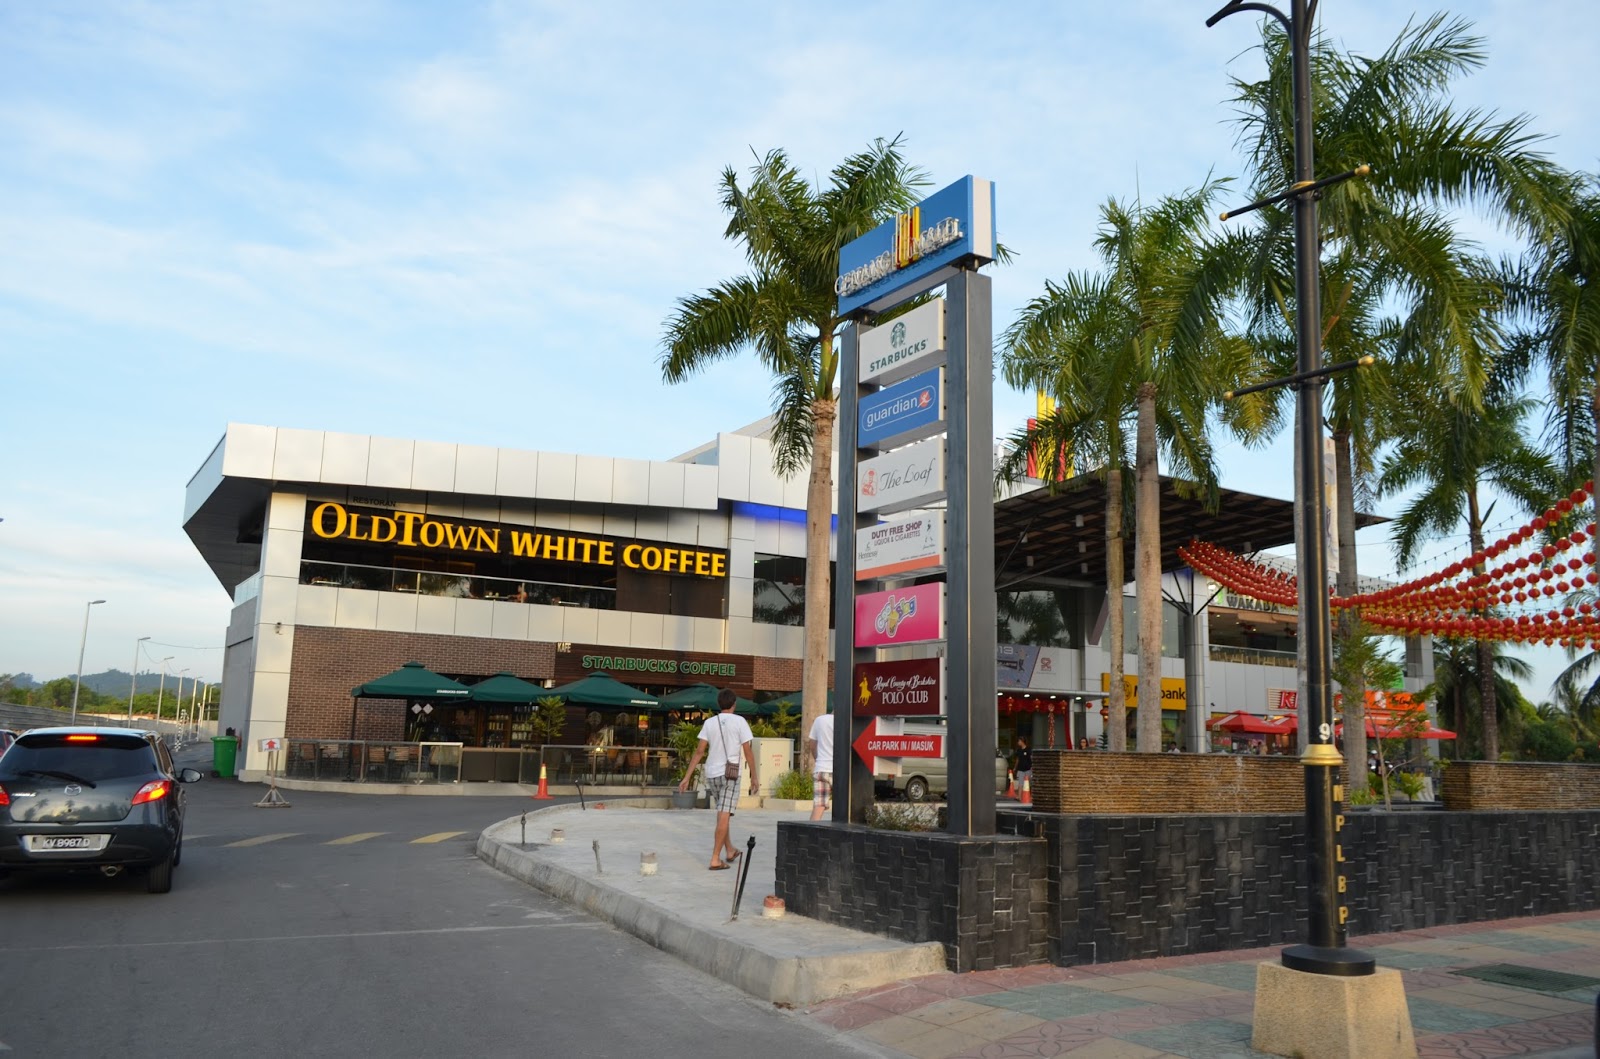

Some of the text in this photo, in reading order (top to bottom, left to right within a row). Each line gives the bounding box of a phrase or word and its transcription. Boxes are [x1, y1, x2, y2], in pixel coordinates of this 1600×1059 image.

[870, 339, 927, 372] STARBUCKS
[866, 395, 918, 427] guardian
[879, 457, 936, 491] The Loaf
[353, 496, 396, 508] RESTORAN
[871, 520, 922, 539] DUTY FREE SHOP
[874, 536, 890, 546] LIQUOR
[894, 530, 920, 542] CIGARETTES
[511, 530, 614, 566] WHITE
[622, 544, 726, 577] COFFEE
[557, 641, 571, 653] KAFE
[582, 655, 736, 676] STARBUCKS COFFEE
[882, 690, 928, 704] POLO CLUB
[1319, 722, 1330, 741] 9
[867, 741, 881, 750] CAR
[881, 741, 899, 750] PARK
[900, 741, 907, 750] IN
[911, 741, 934, 751] MASUK
